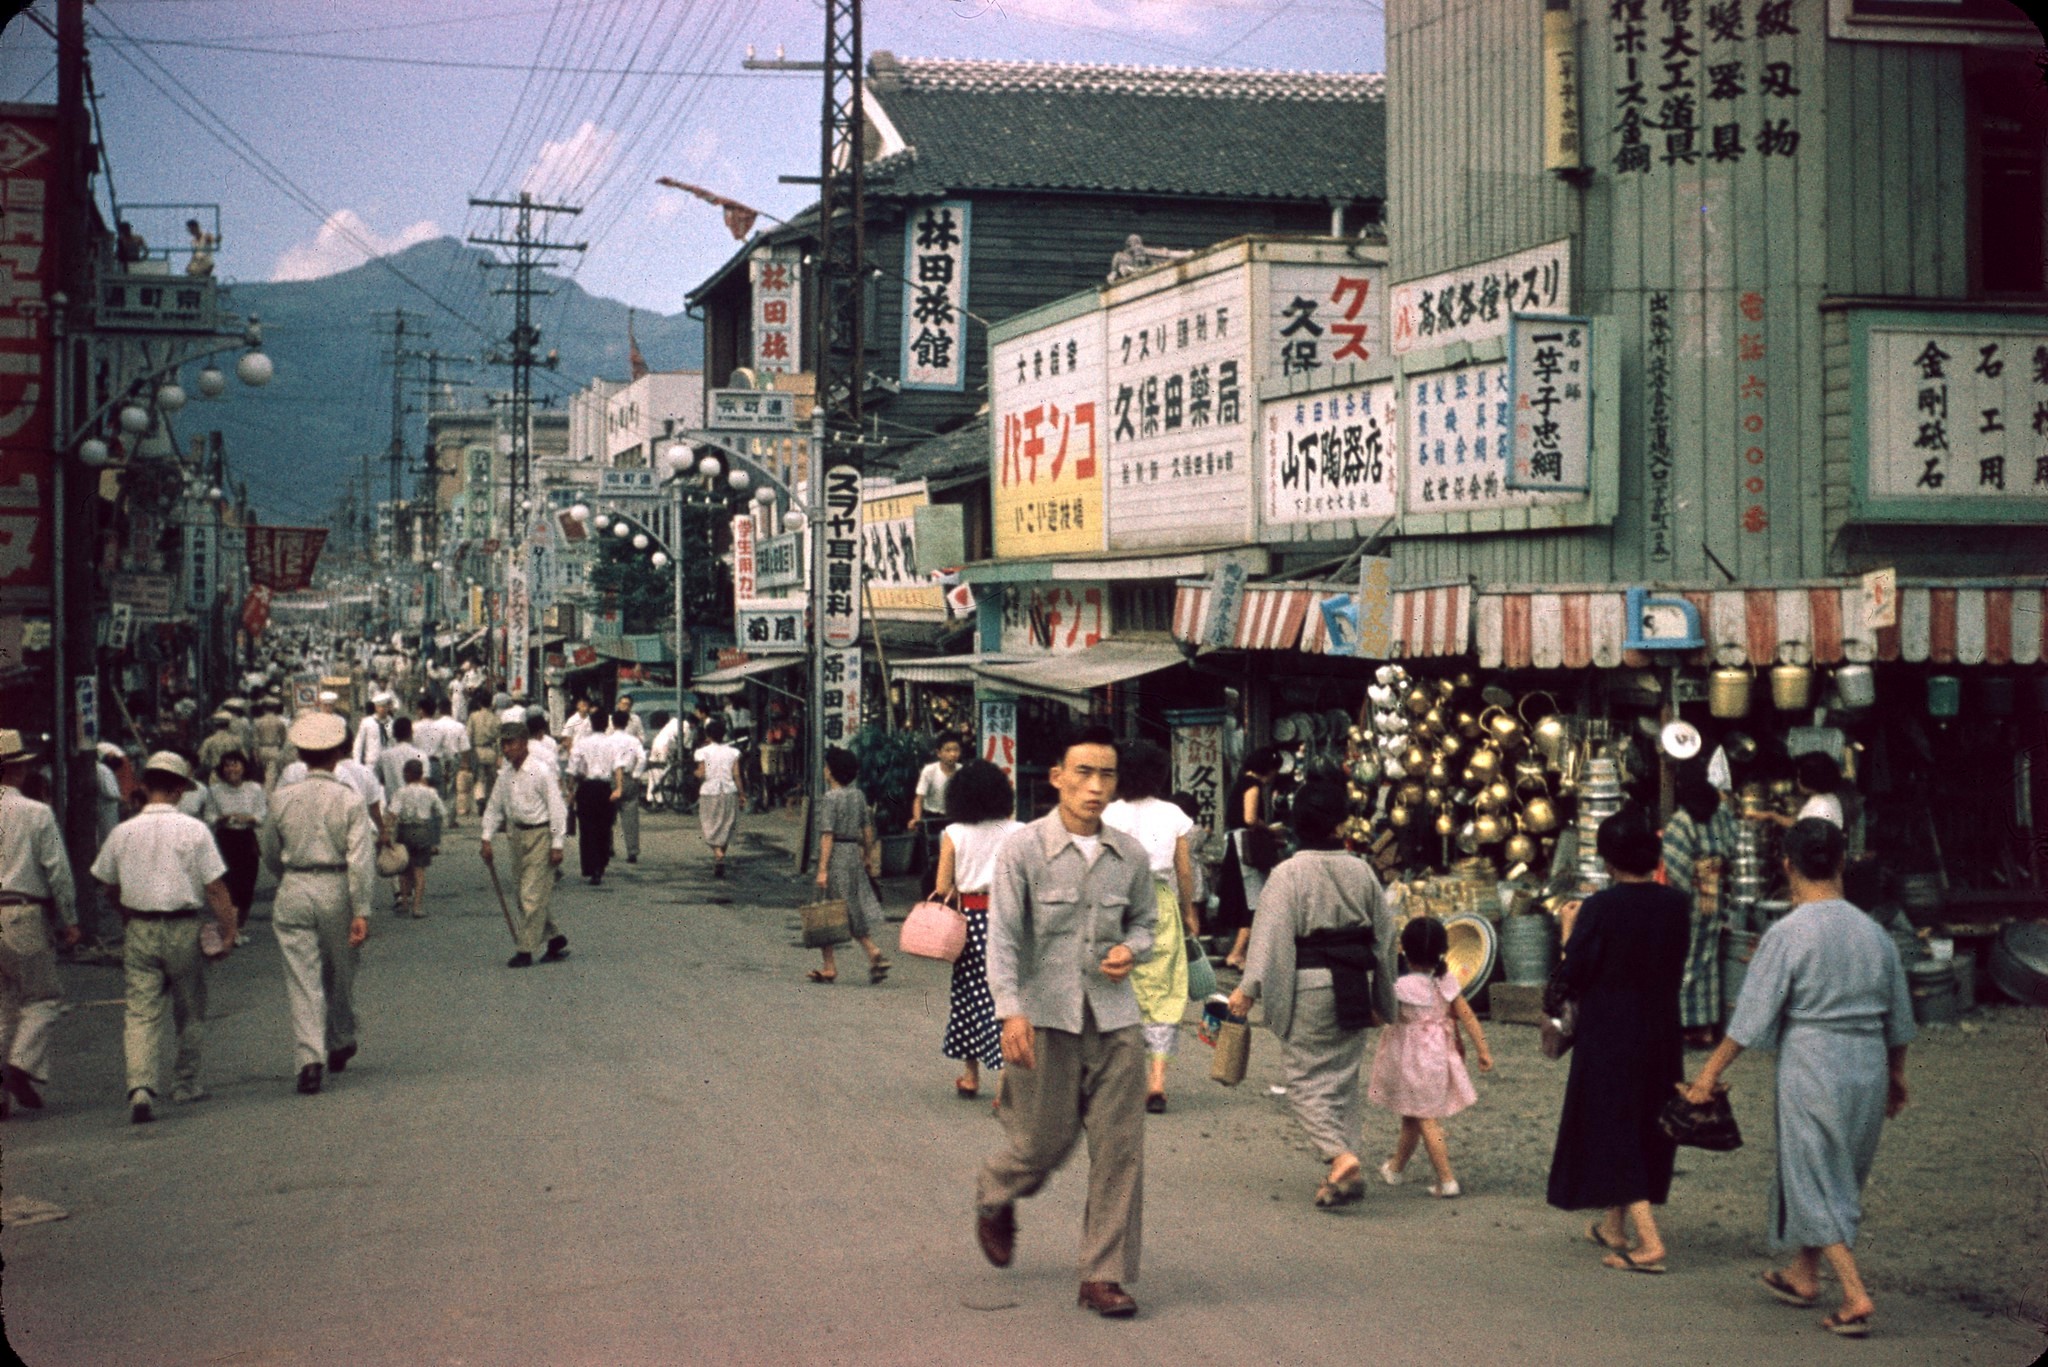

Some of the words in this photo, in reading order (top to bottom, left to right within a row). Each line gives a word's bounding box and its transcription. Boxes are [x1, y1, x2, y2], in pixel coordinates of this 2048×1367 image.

[761, 262, 789, 373] 林田旅
[910, 208, 961, 369] 林田旅館
[1280, 296, 1324, 377] 久保
[1001, 401, 1097, 488] パチンコ
[1114, 360, 1241, 442] 久保田薬局
[1914, 341, 1950, 489] 金剛砥石
[1975, 343, 2005, 490] 石工用
[1281, 416, 1383, 494] 山下陶器店
